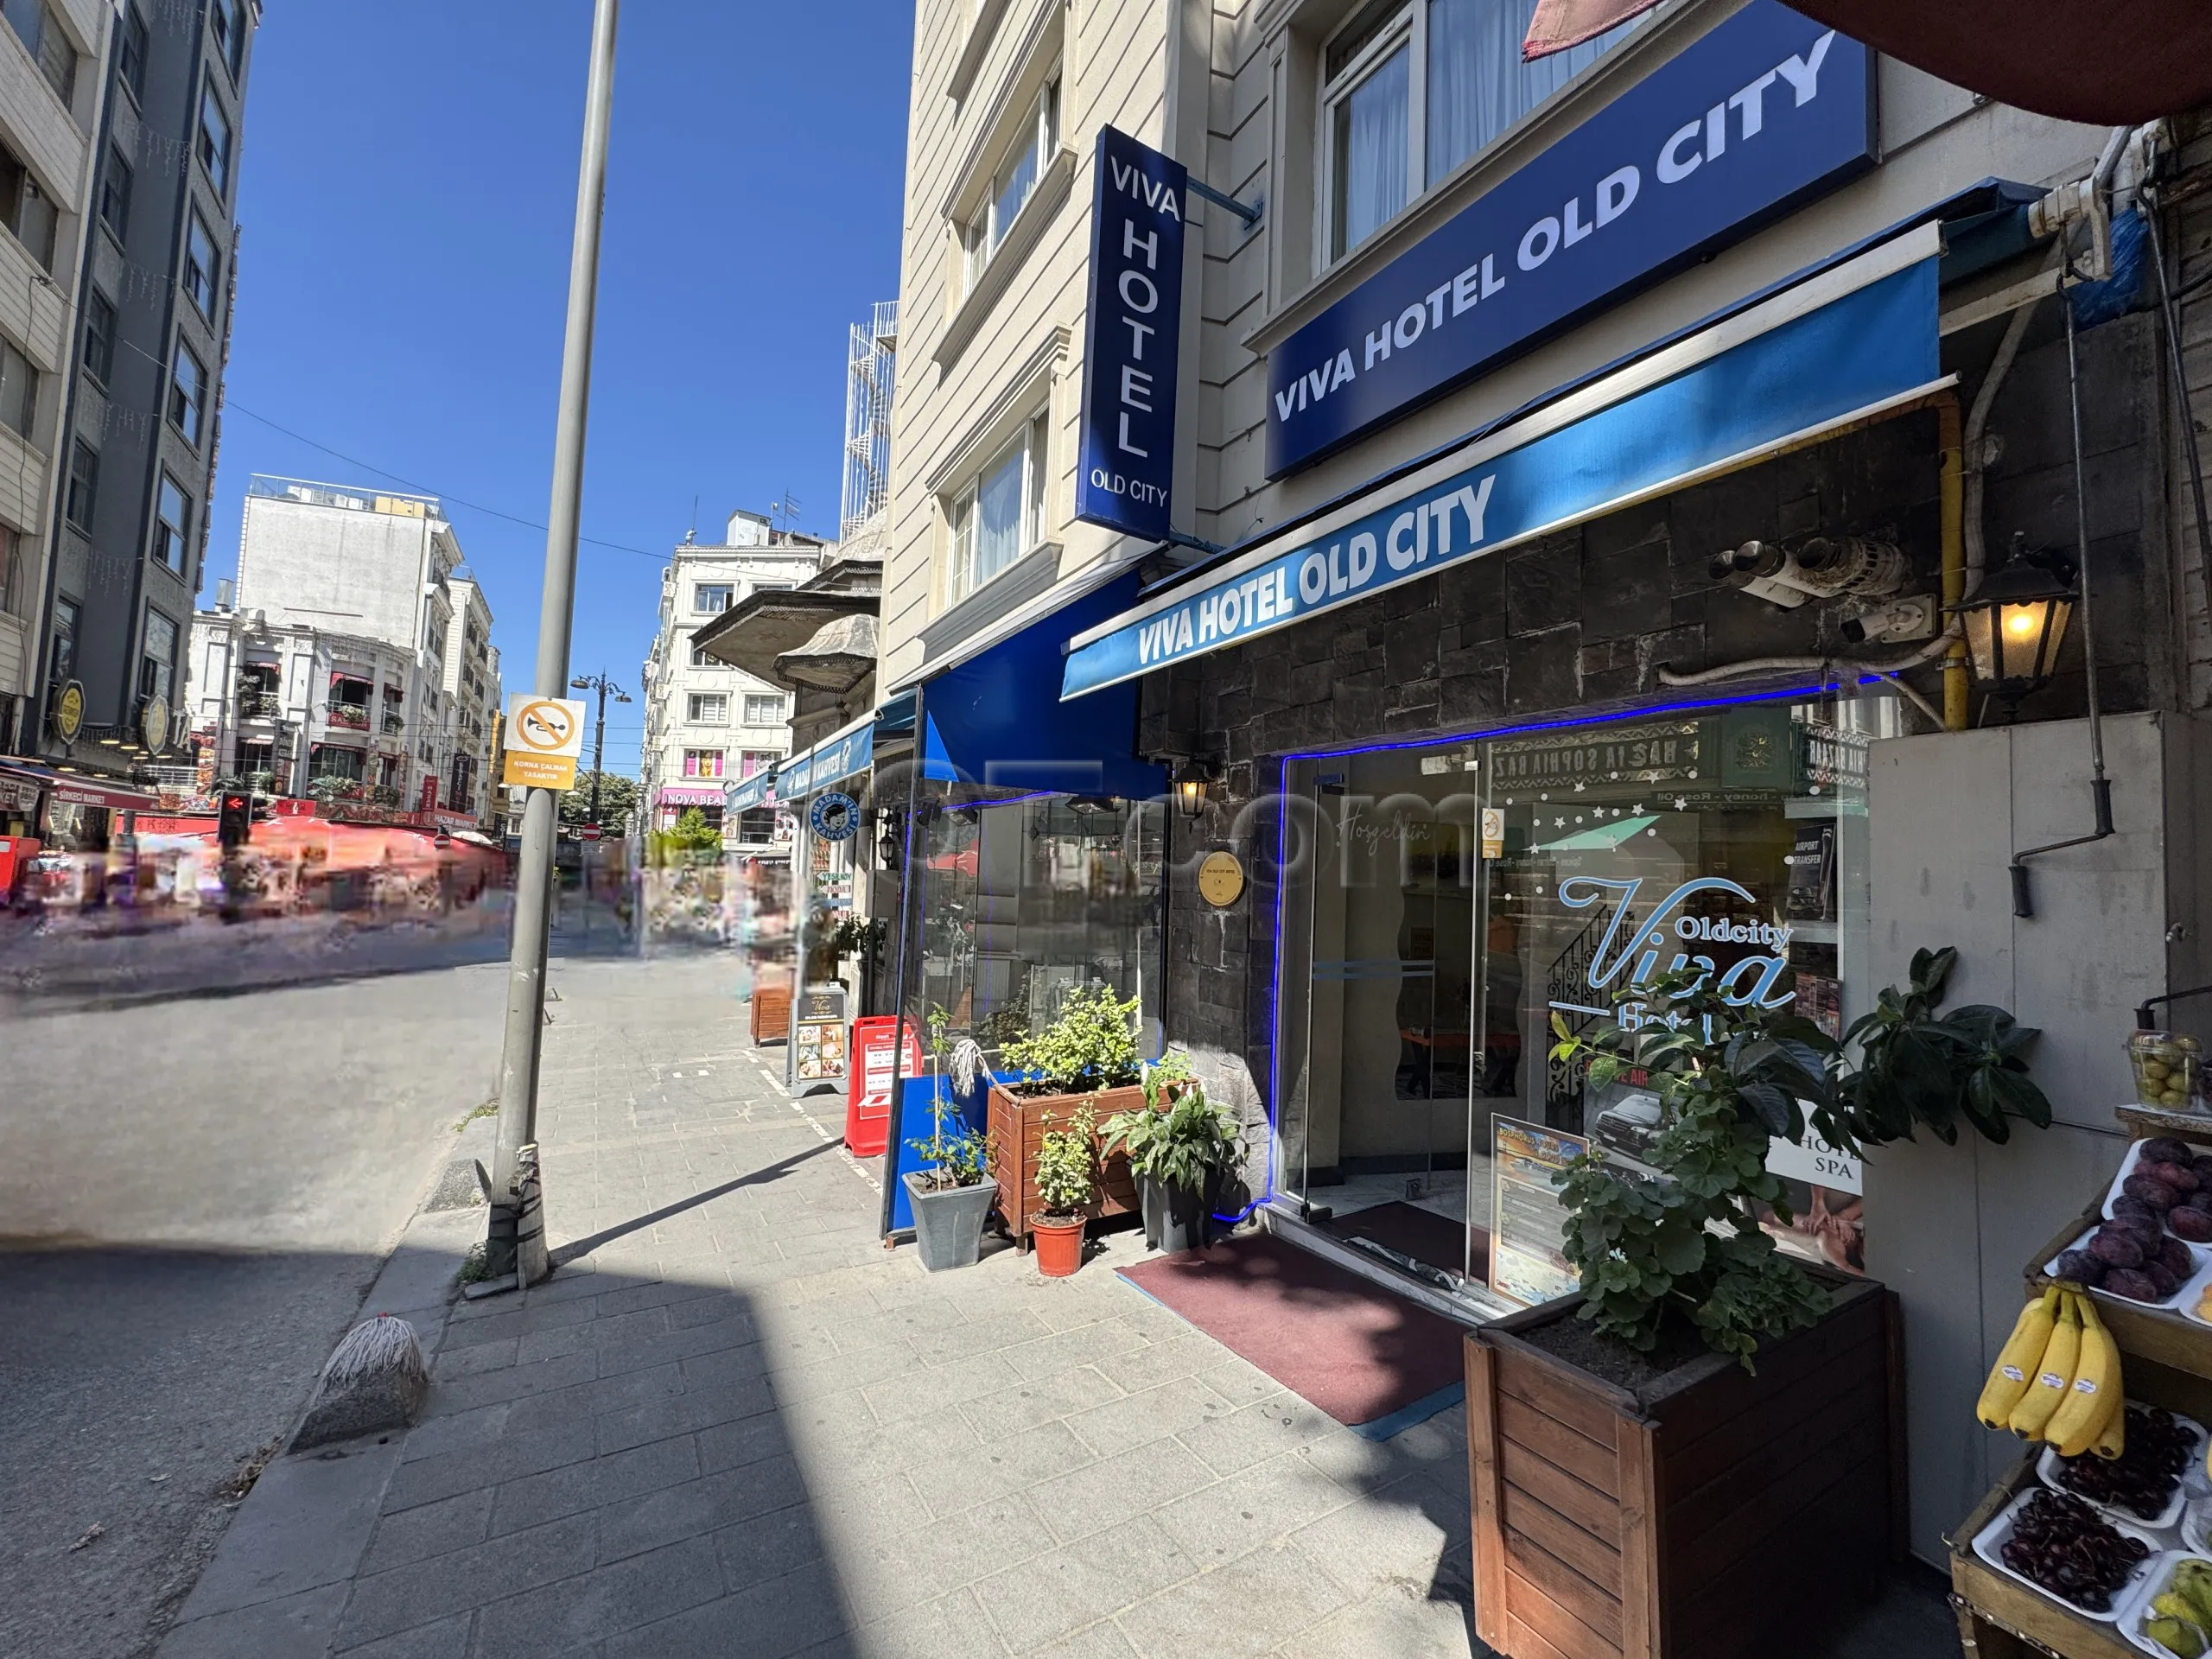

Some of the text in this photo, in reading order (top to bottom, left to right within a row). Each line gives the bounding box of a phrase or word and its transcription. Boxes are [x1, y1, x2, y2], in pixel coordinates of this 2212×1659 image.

[1110, 155, 1181, 222] VIVA
[1274, 29, 1836, 423] VIVA HOTEL OLD CITY
[1116, 218, 1160, 459] HOTEL
[1090, 468, 1169, 508] OLD CITY
[1139, 475, 1497, 664] VIVA HOTEL OLD CITY
[514, 760, 539, 770] KORNA
[523, 770, 558, 781] YASAKTIR
[59, 788, 105, 804] SİRKECİ MARKET
[667, 793, 697, 805] NOVA
[1795, 840, 1819, 852] AIRPORT
[1794, 854, 1821, 865] TRANSFER
[1558, 875, 1797, 1010] Viva
[1675, 915, 1795, 950] Oldcity
[811, 999, 830, 1011] Viva
[1618, 1001, 1714, 1046] Hotl
[1499, 1127, 1535, 1145] BOSPHORUS
[1815, 1157, 1855, 1180] SPA
